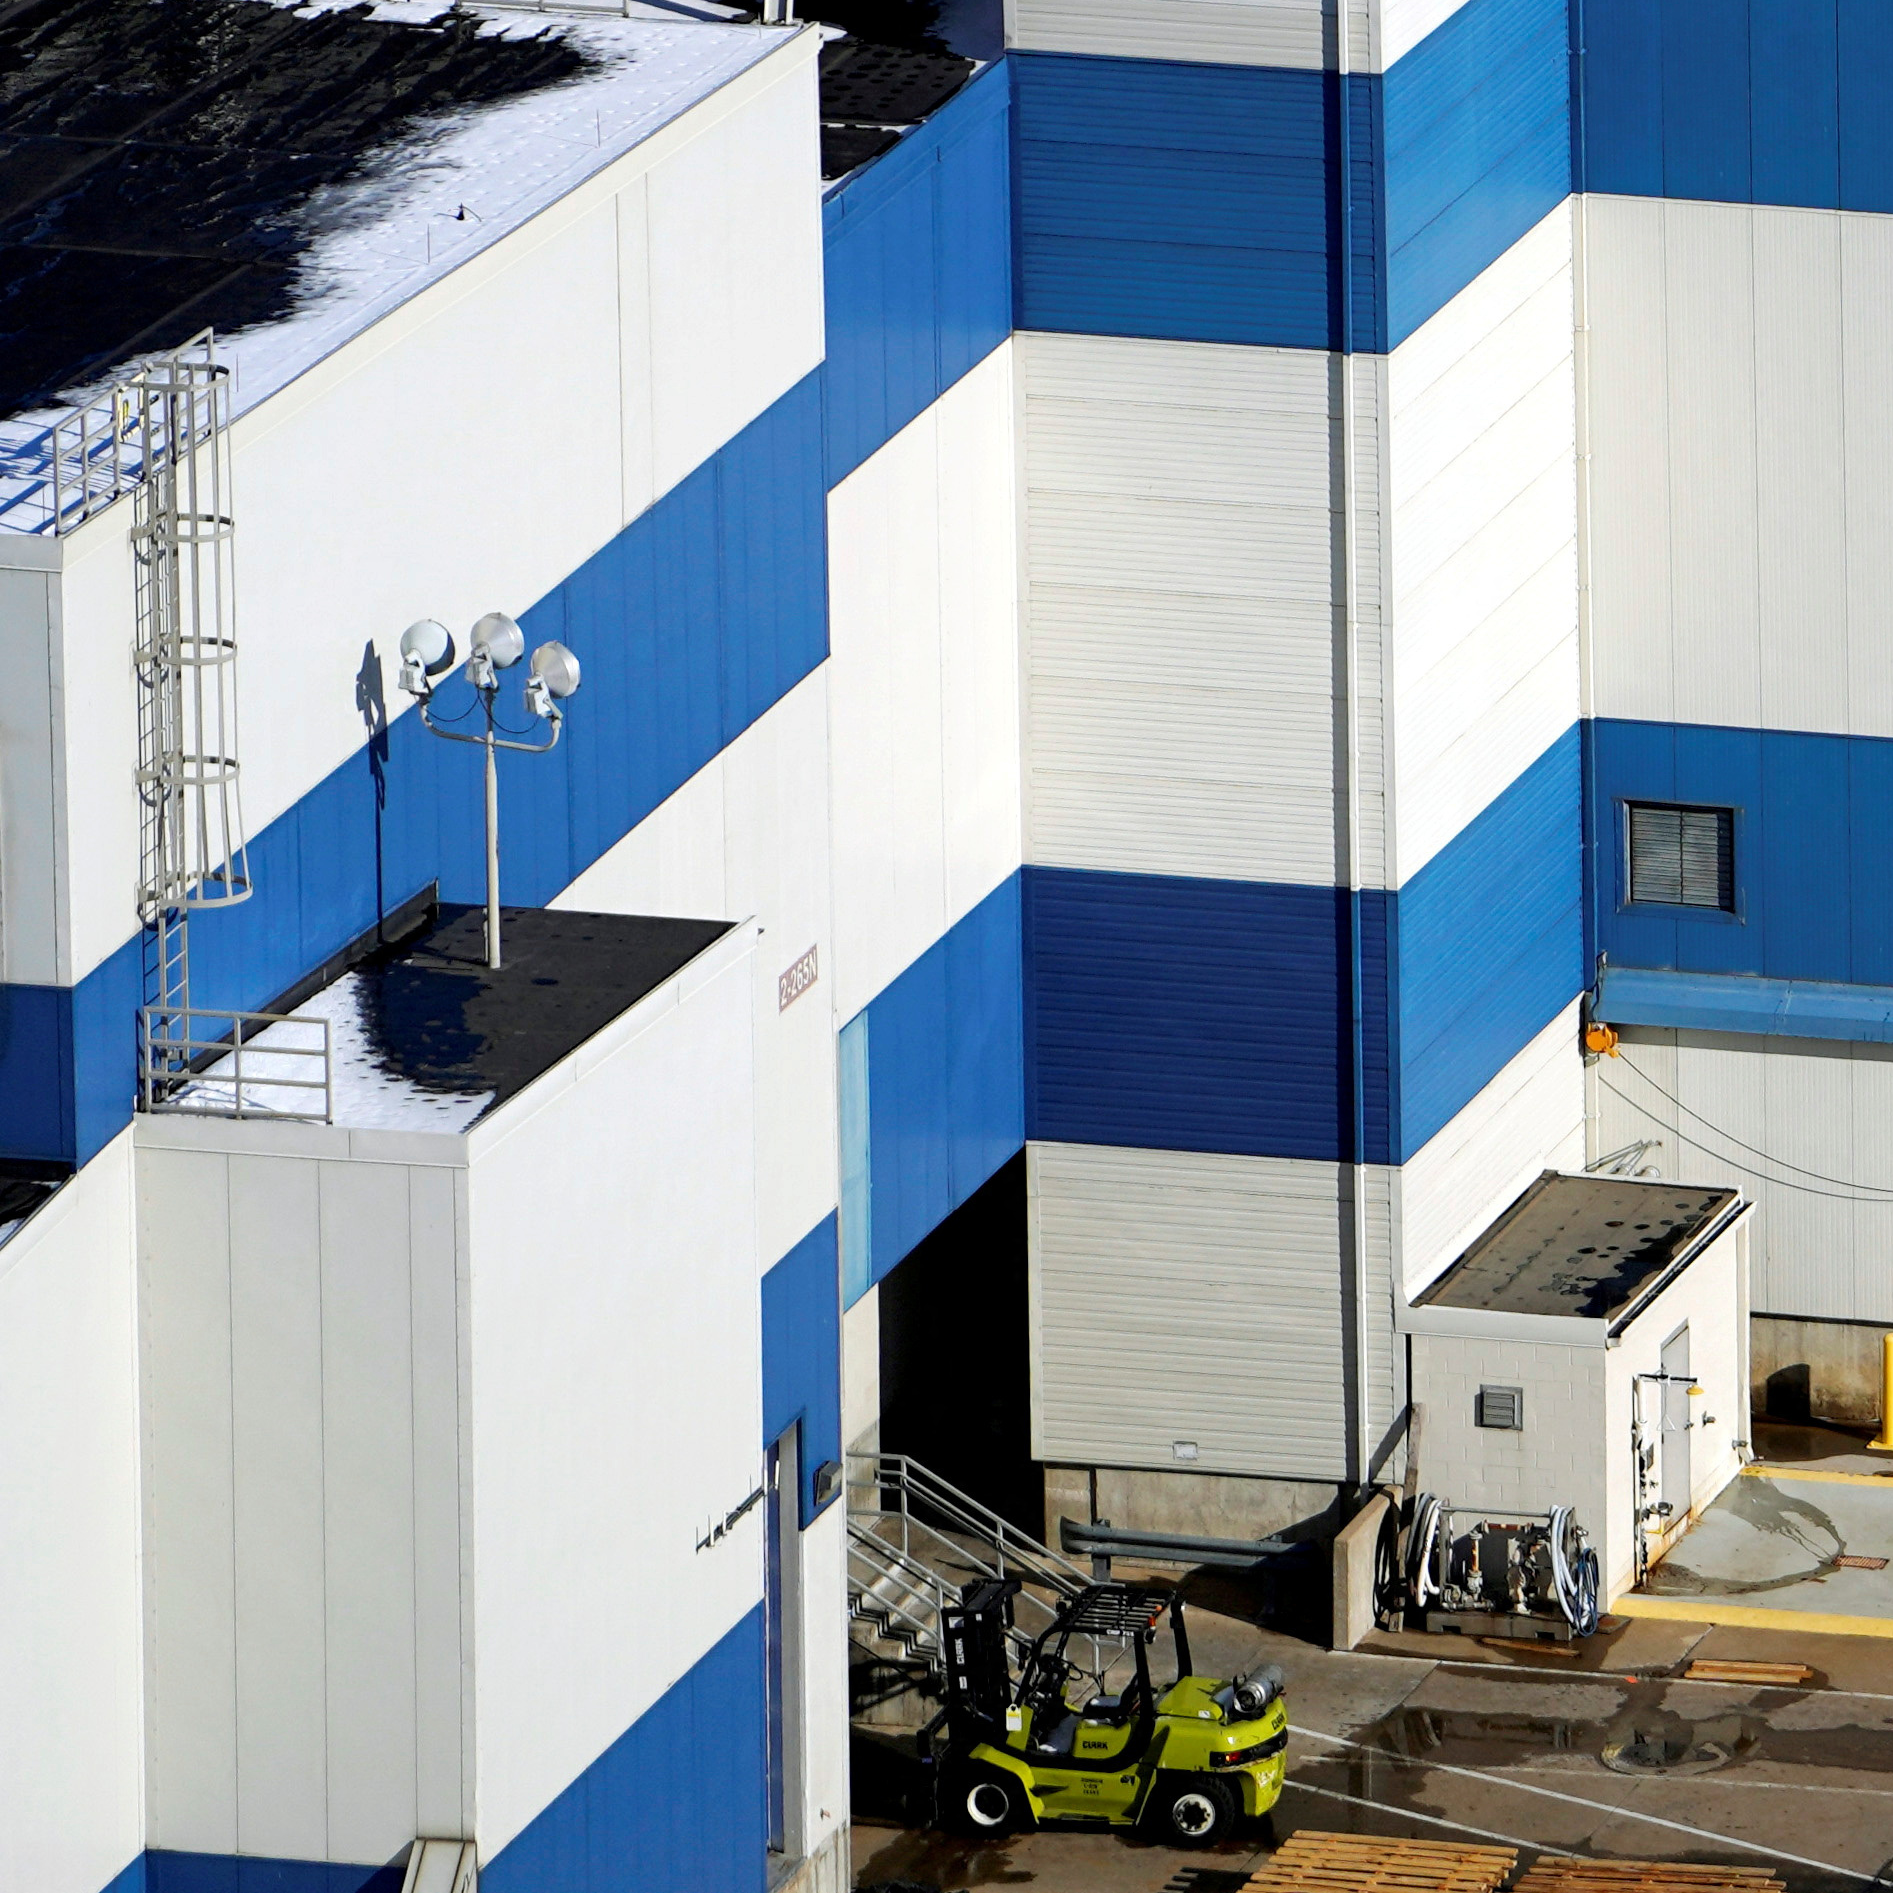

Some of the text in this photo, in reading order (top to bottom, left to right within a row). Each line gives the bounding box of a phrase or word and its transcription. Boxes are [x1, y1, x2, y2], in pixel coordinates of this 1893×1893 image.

[780, 949, 817, 1007] 2-265N
[955, 1638, 965, 1665] CLARK
[1082, 1740, 1108, 1750] CLARK
